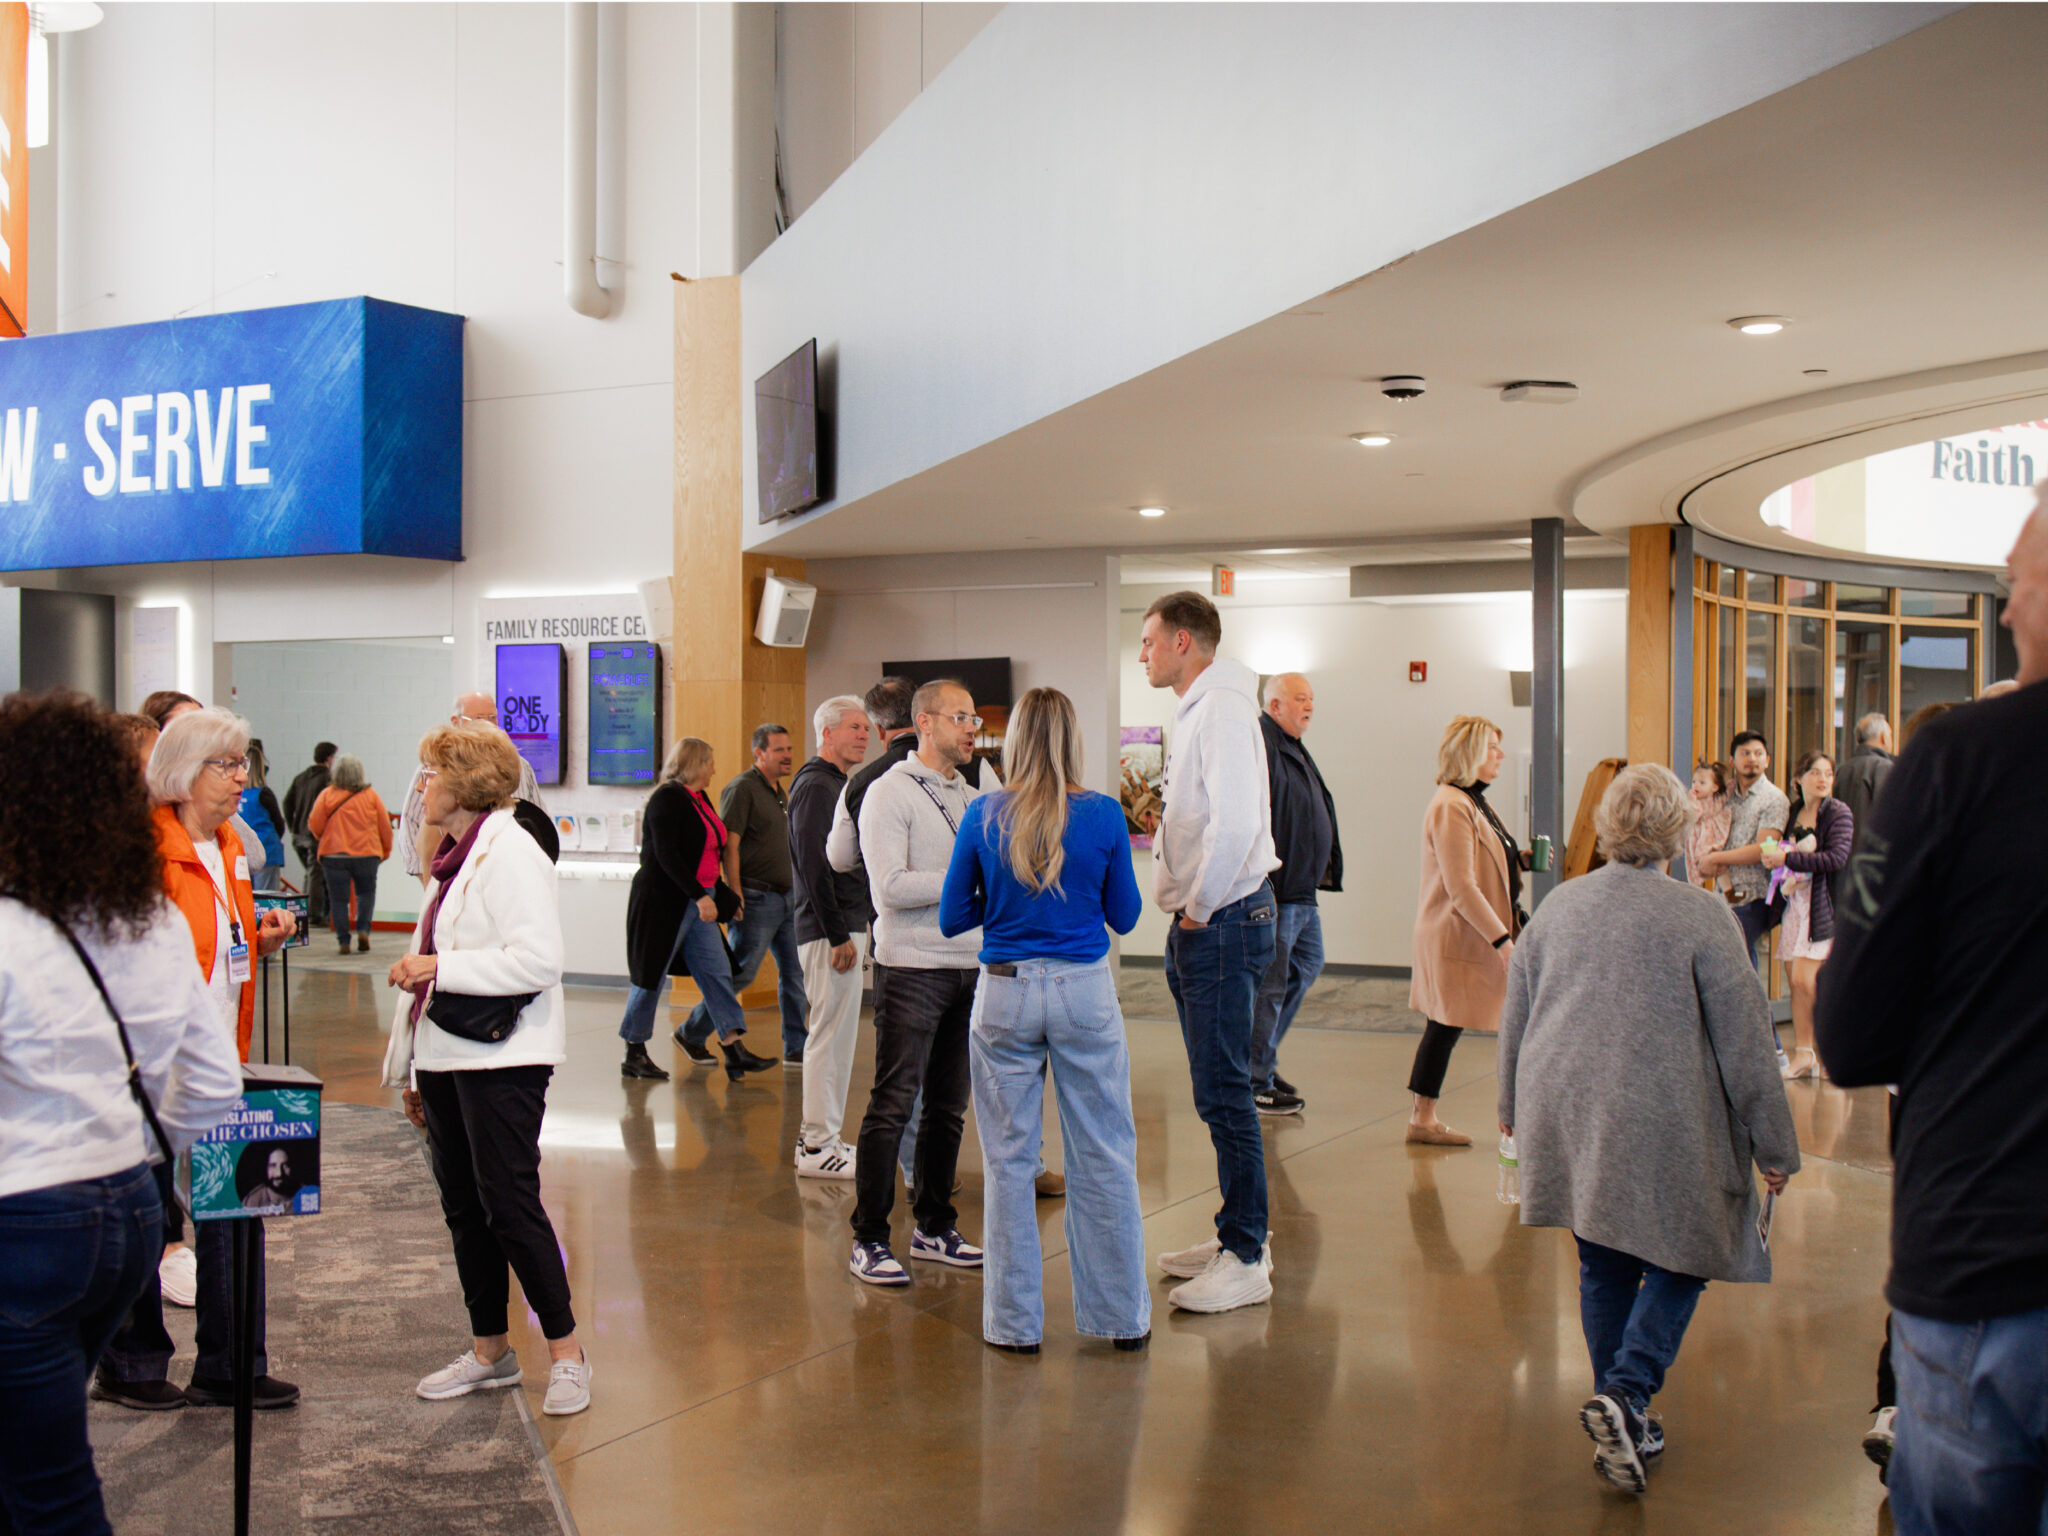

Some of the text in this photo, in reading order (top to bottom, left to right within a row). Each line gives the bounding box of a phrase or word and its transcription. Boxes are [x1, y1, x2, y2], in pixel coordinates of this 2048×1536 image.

[83, 384, 271, 497] SERVE
[1930, 440, 2034, 487] Faith
[486, 619, 537, 640] FAMILY
[542, 616, 619, 638] RESOURCE
[504, 696, 541, 714] ONE
[240, 1121, 313, 1140] CHOSEN
